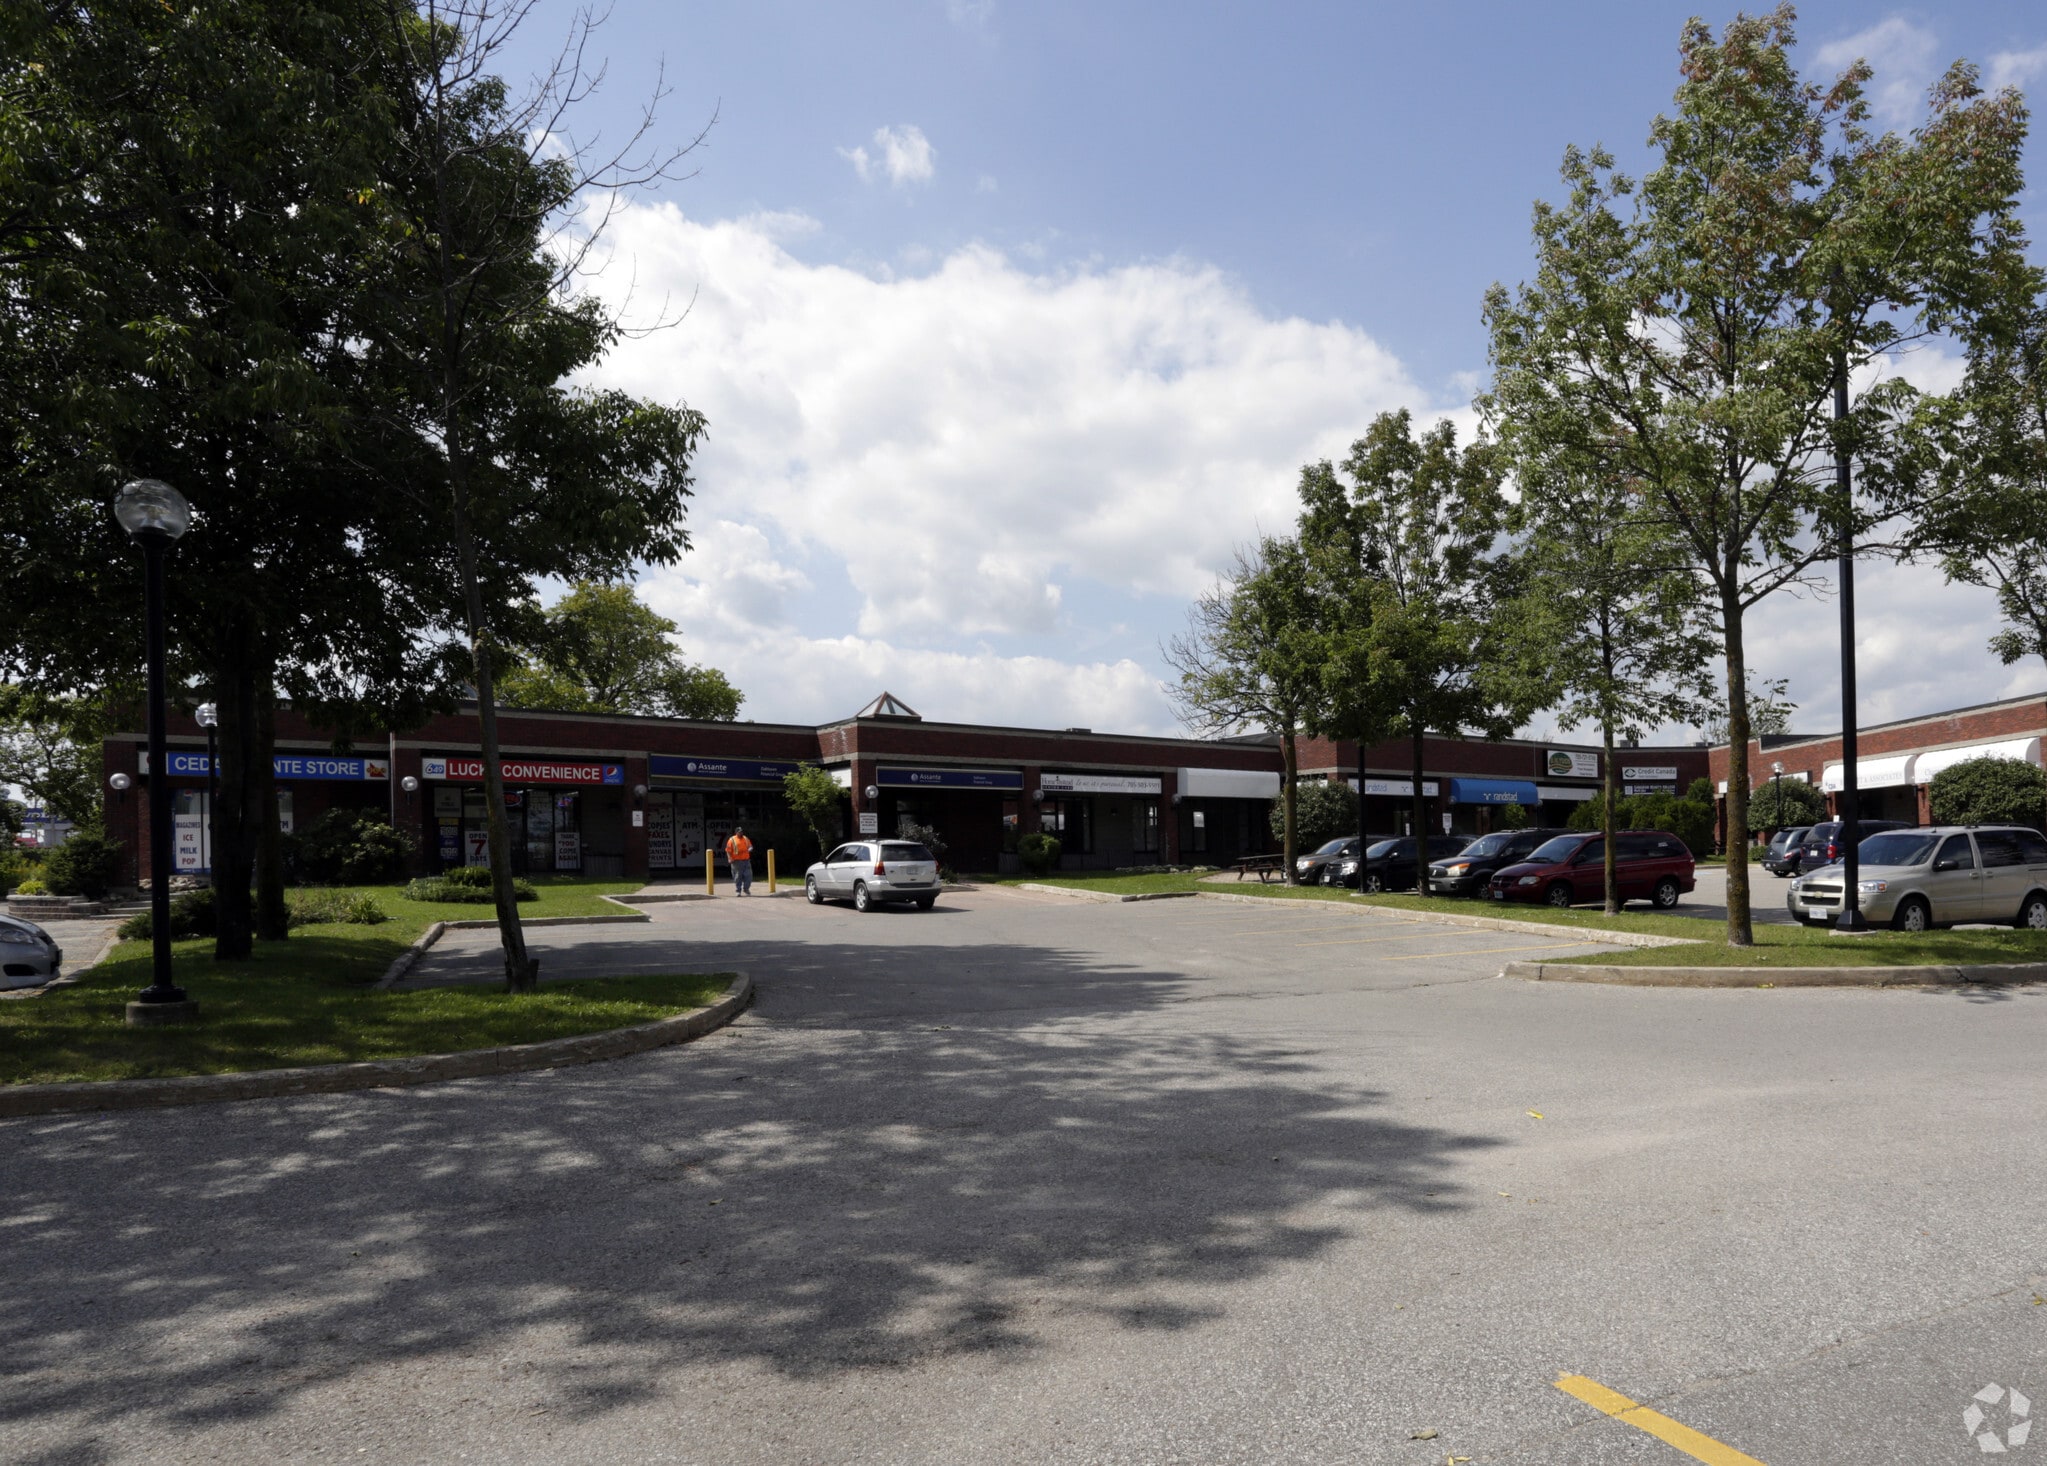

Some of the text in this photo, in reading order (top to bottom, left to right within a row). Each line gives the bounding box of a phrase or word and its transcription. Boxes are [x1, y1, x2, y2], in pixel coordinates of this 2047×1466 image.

[306, 760, 359, 775] STORE
[449, 763, 600, 780] LUCK CONVENIENCE
[698, 763, 727, 771] Assante
[1494, 791, 1518, 802] randstad
[470, 839, 486, 855] 7
[714, 832, 727, 849] 7
[182, 857, 195, 865] POP
